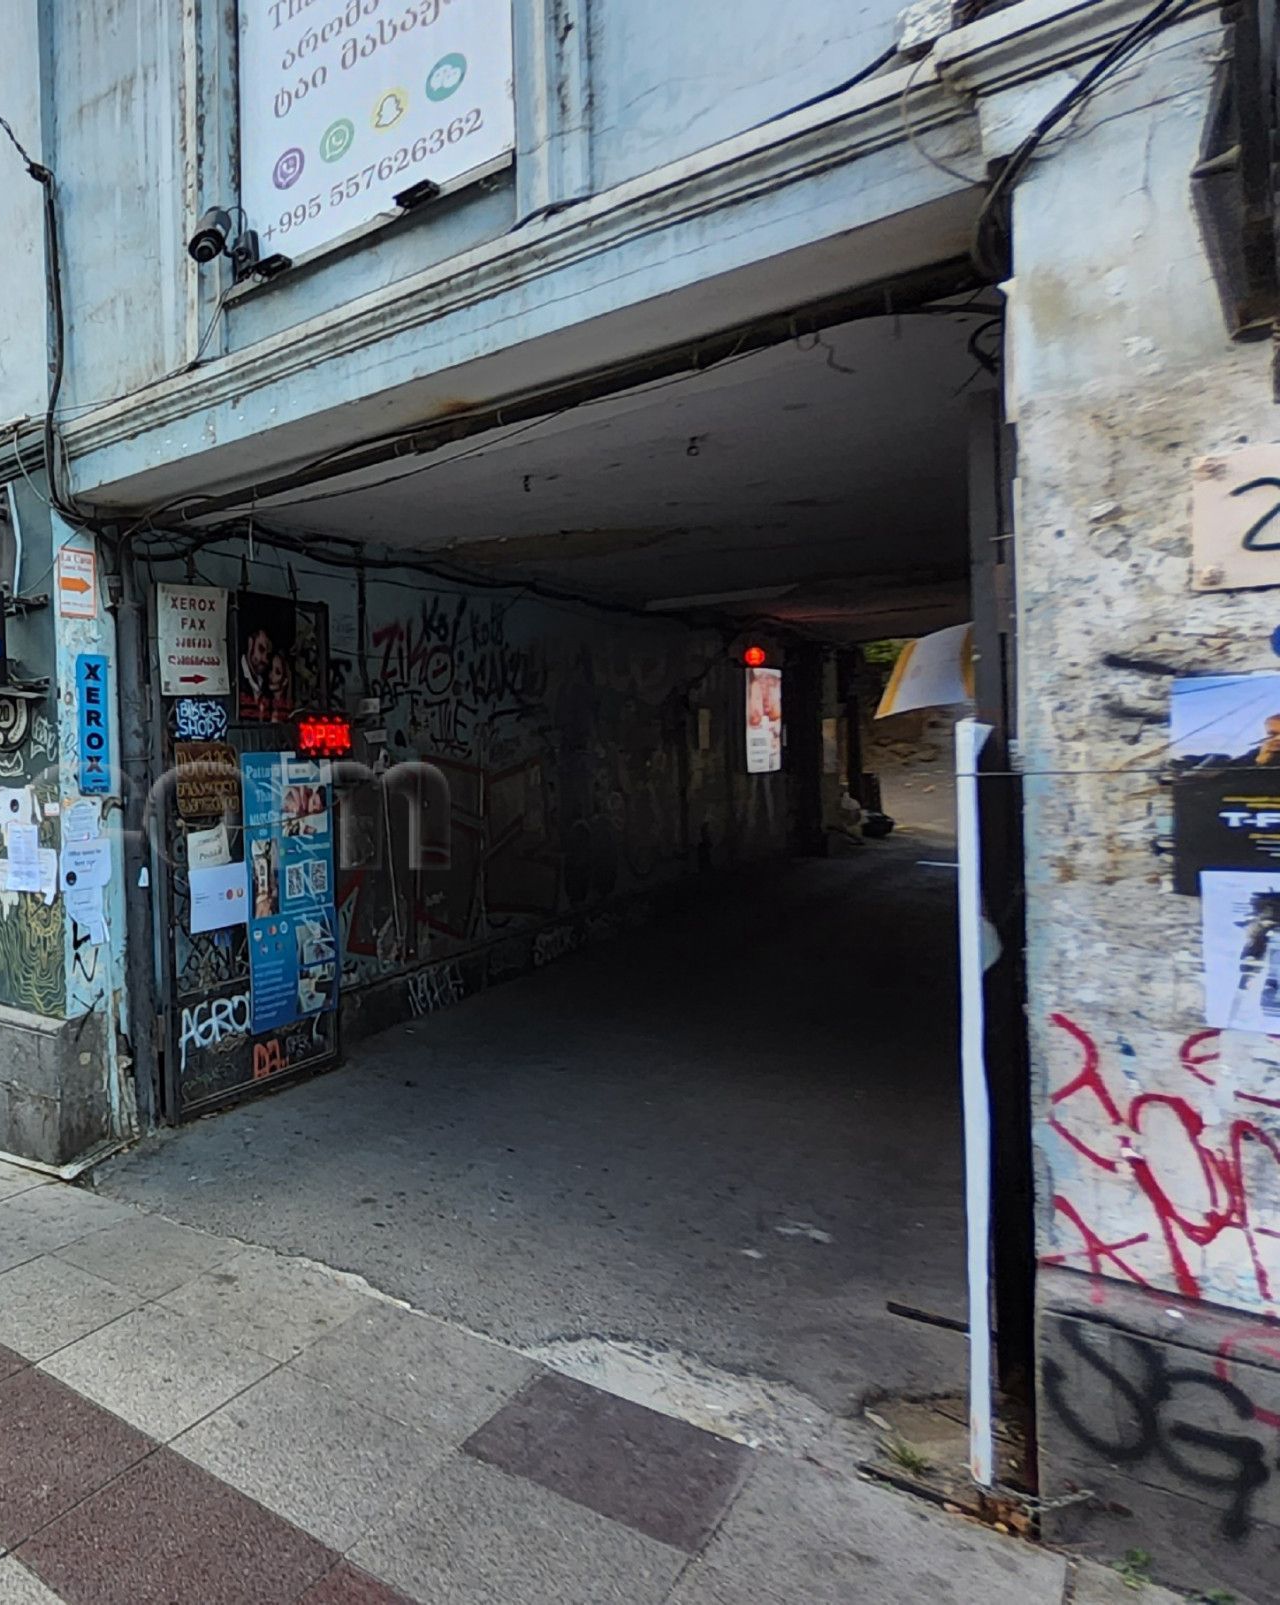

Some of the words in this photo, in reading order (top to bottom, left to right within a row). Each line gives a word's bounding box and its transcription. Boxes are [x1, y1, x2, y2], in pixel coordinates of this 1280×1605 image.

[274, 66, 327, 118] ტაი
[341, 0, 453, 70] მასაჟ
[261, 194, 322, 242] +995
[329, 107, 484, 207] 557626362
[170, 596, 216, 612] XEROX
[180, 617, 206, 631] FAX
[84, 661, 104, 774] XEROX
[180, 702, 207, 719] BIKE
[180, 719, 215, 736] SHOP
[301, 724, 350, 747] OPEN
